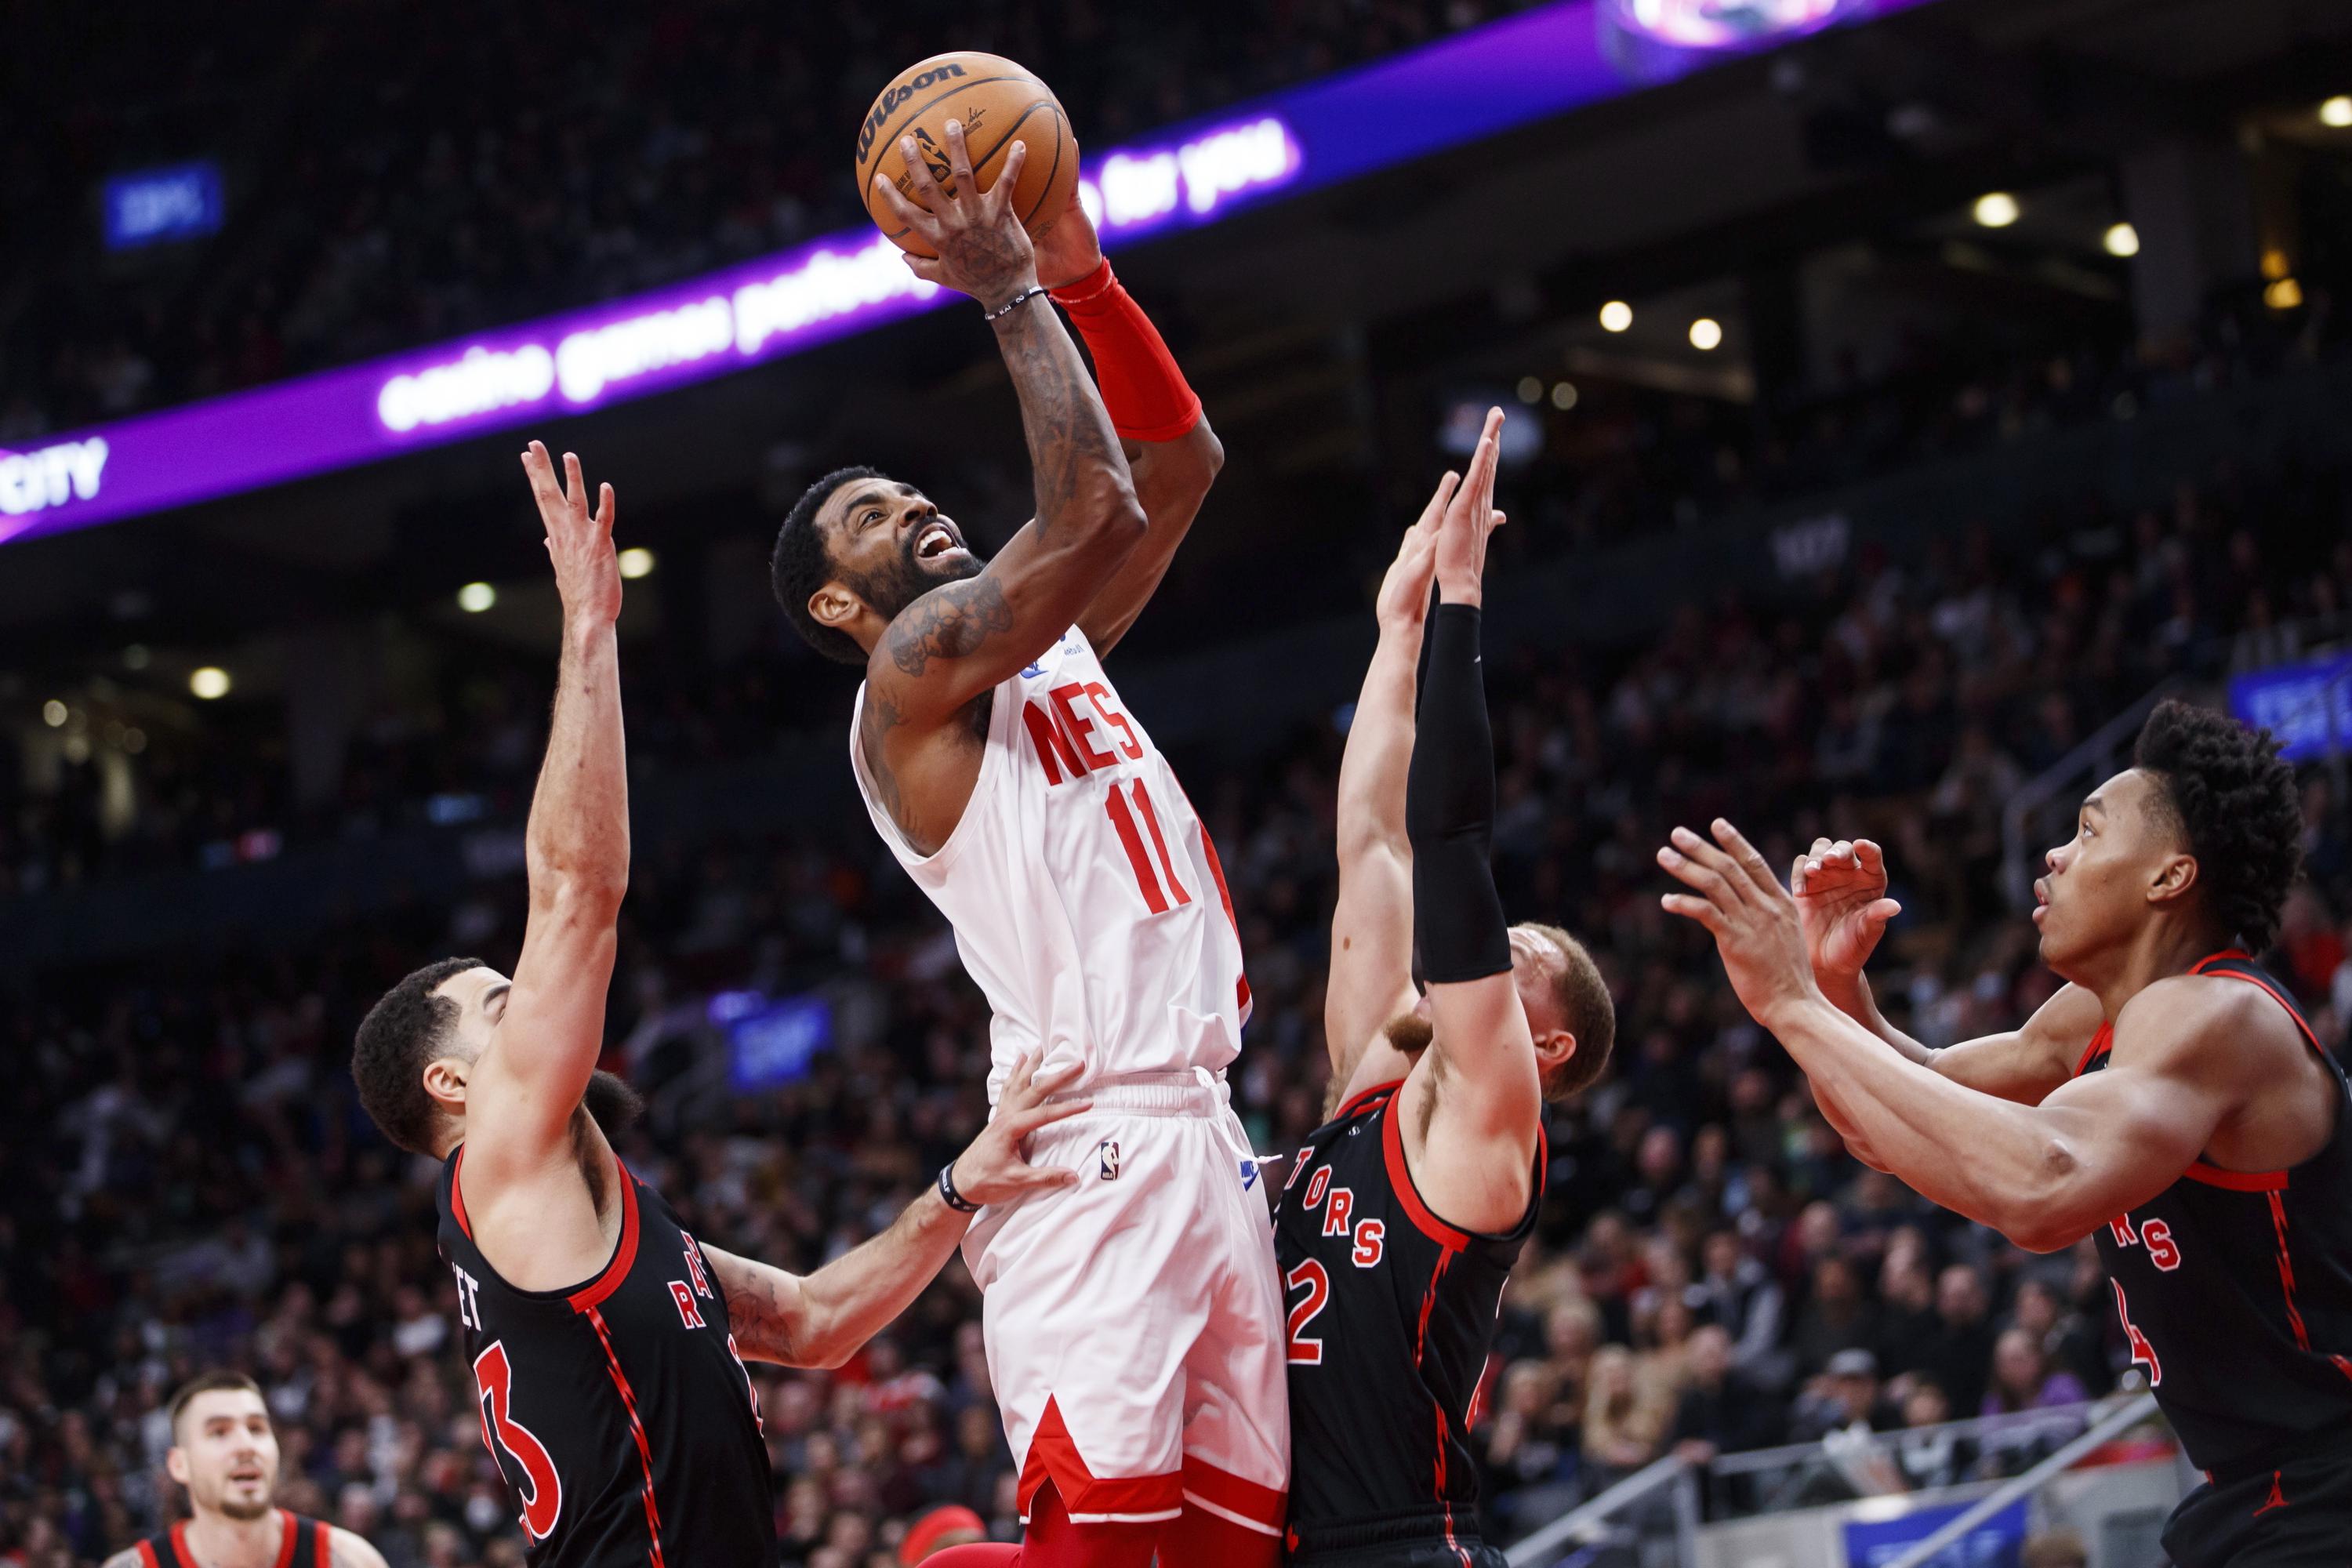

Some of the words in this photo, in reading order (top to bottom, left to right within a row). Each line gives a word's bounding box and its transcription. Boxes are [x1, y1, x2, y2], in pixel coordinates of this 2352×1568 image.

[856, 62, 967, 165] Wilson
[1105, 776, 1192, 916] 11
[1278, 1258, 1329, 1365] 2
